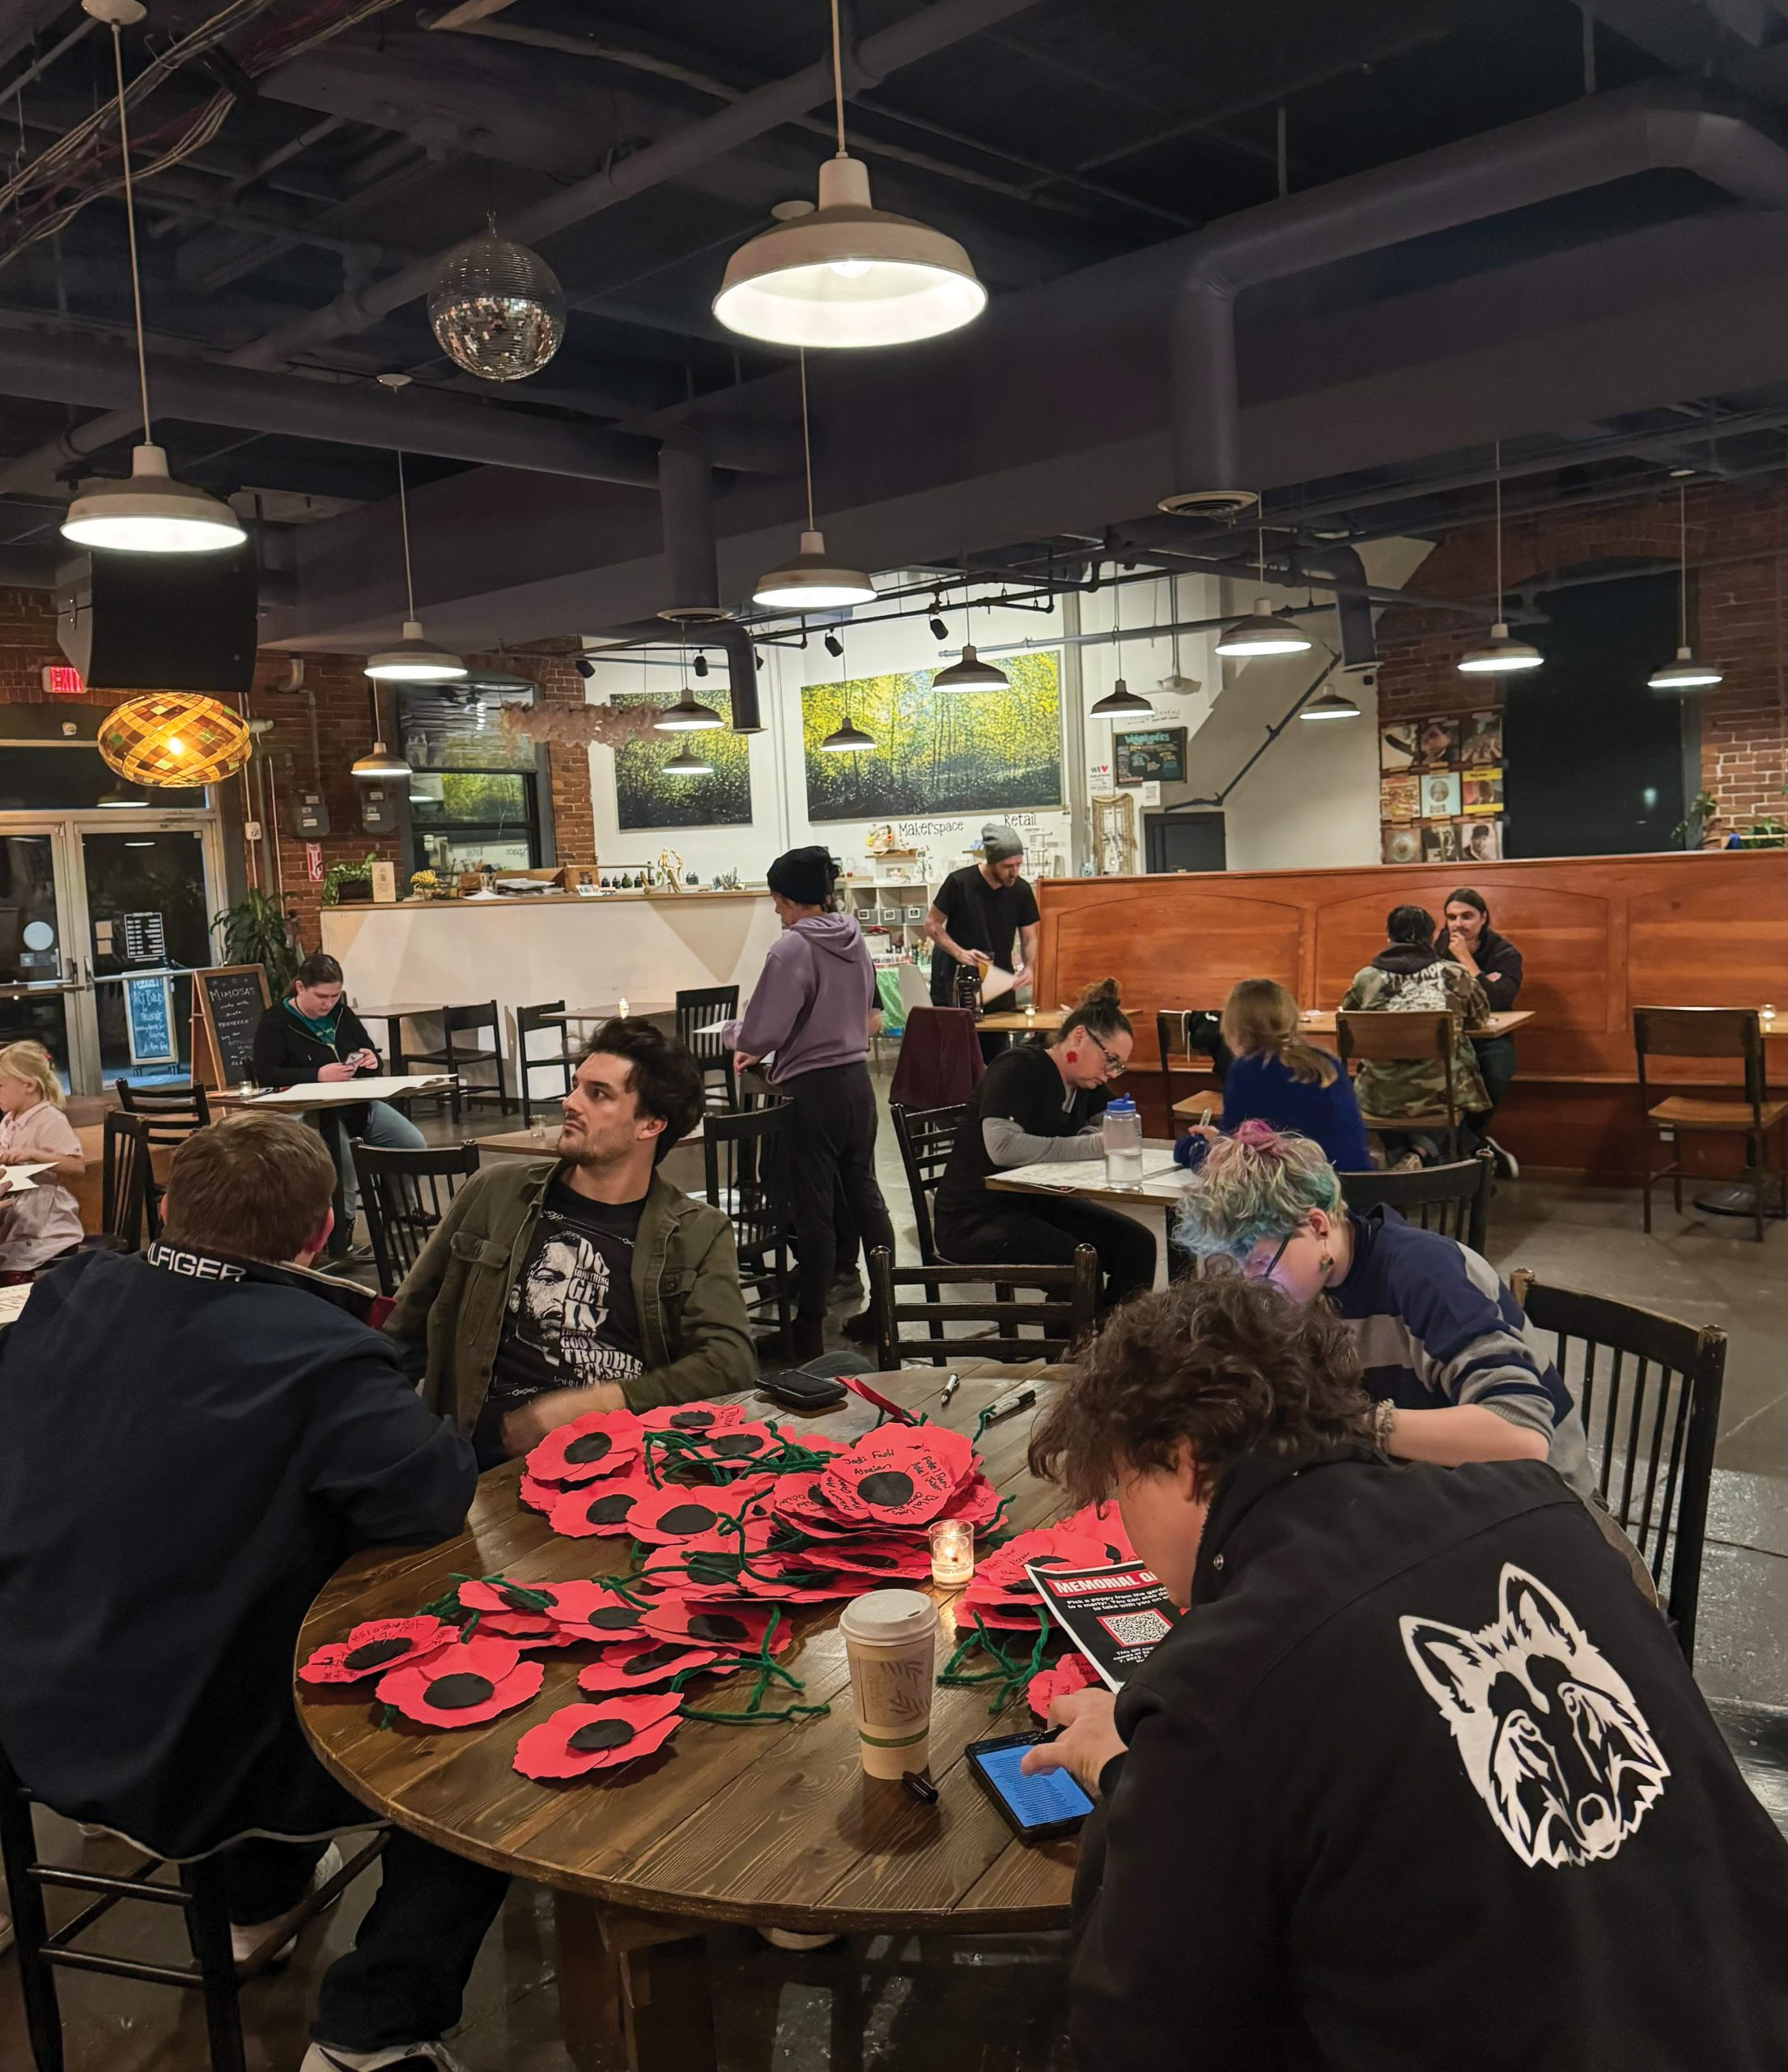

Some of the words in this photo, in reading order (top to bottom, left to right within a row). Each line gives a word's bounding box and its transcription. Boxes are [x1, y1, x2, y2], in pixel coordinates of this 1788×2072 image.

[898, 821, 963, 837] Makerspace
[1004, 813, 1037, 827] Retail
[568, 1278, 608, 1308] GET
[562, 1298, 609, 1332] IN
[561, 1348, 643, 1376] TROUBLE
[1053, 1574, 1140, 1594] MEMORIAL
